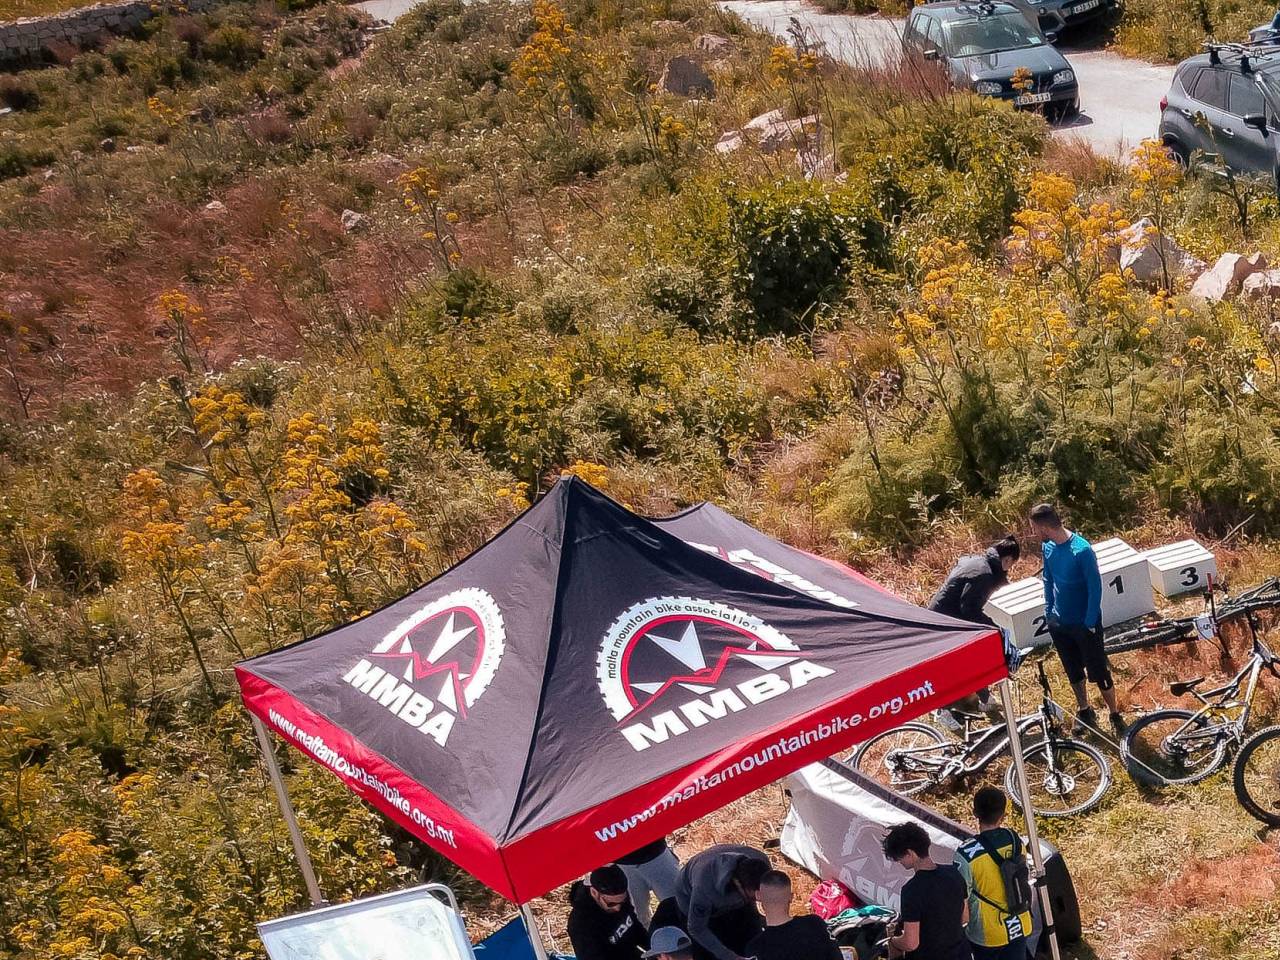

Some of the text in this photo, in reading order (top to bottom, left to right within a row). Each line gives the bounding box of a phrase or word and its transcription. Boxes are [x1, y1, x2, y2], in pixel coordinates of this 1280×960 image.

[1108, 574, 1125, 595] 1
[1179, 566, 1200, 587] 3
[606, 603, 758, 680] malta mountain bike association
[1031, 615, 1049, 638] 2
[341, 658, 457, 748] MMBA
[619, 661, 838, 752] MMBA
[268, 708, 458, 849] www.maltamountainbike.org.mt
[594, 679, 937, 843] www.maltamountainbike.org.mt
[1006, 915, 1022, 941] FOX
